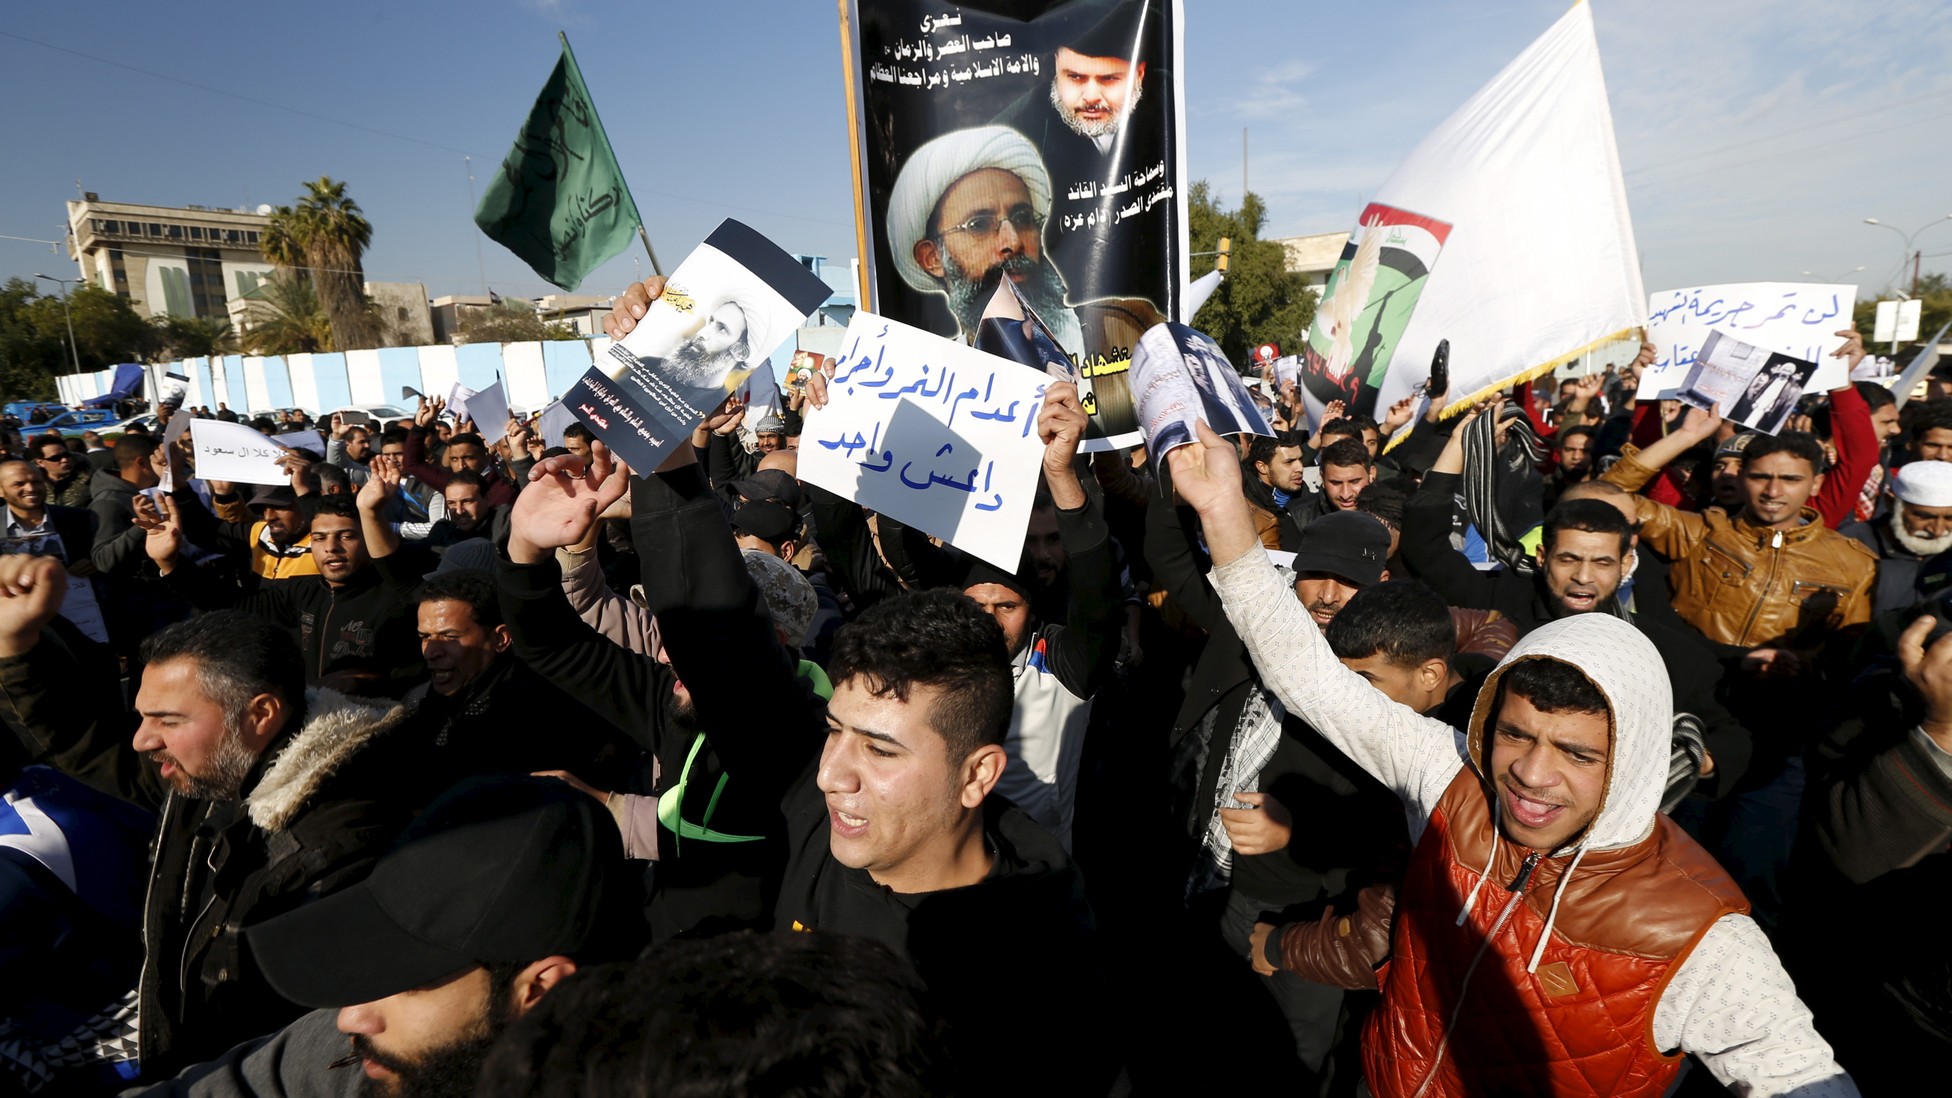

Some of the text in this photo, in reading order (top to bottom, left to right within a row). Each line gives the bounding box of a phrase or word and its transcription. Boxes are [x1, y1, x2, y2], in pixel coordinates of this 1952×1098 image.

[894, 38, 933, 62] والزمان
[936, 34, 970, 60] العصر
[972, 31, 1011, 53] صاحب
[1134, 160, 1165, 186] وسماحة
[1114, 196, 1143, 224] الصدر
[1802, 295, 1839, 324] لن
[878, 364, 955, 404] النمر
[203, 445, 234, 456] سعود
[254, 449, 269, 458] كلا
[818, 422, 1003, 512] داعش واحد
